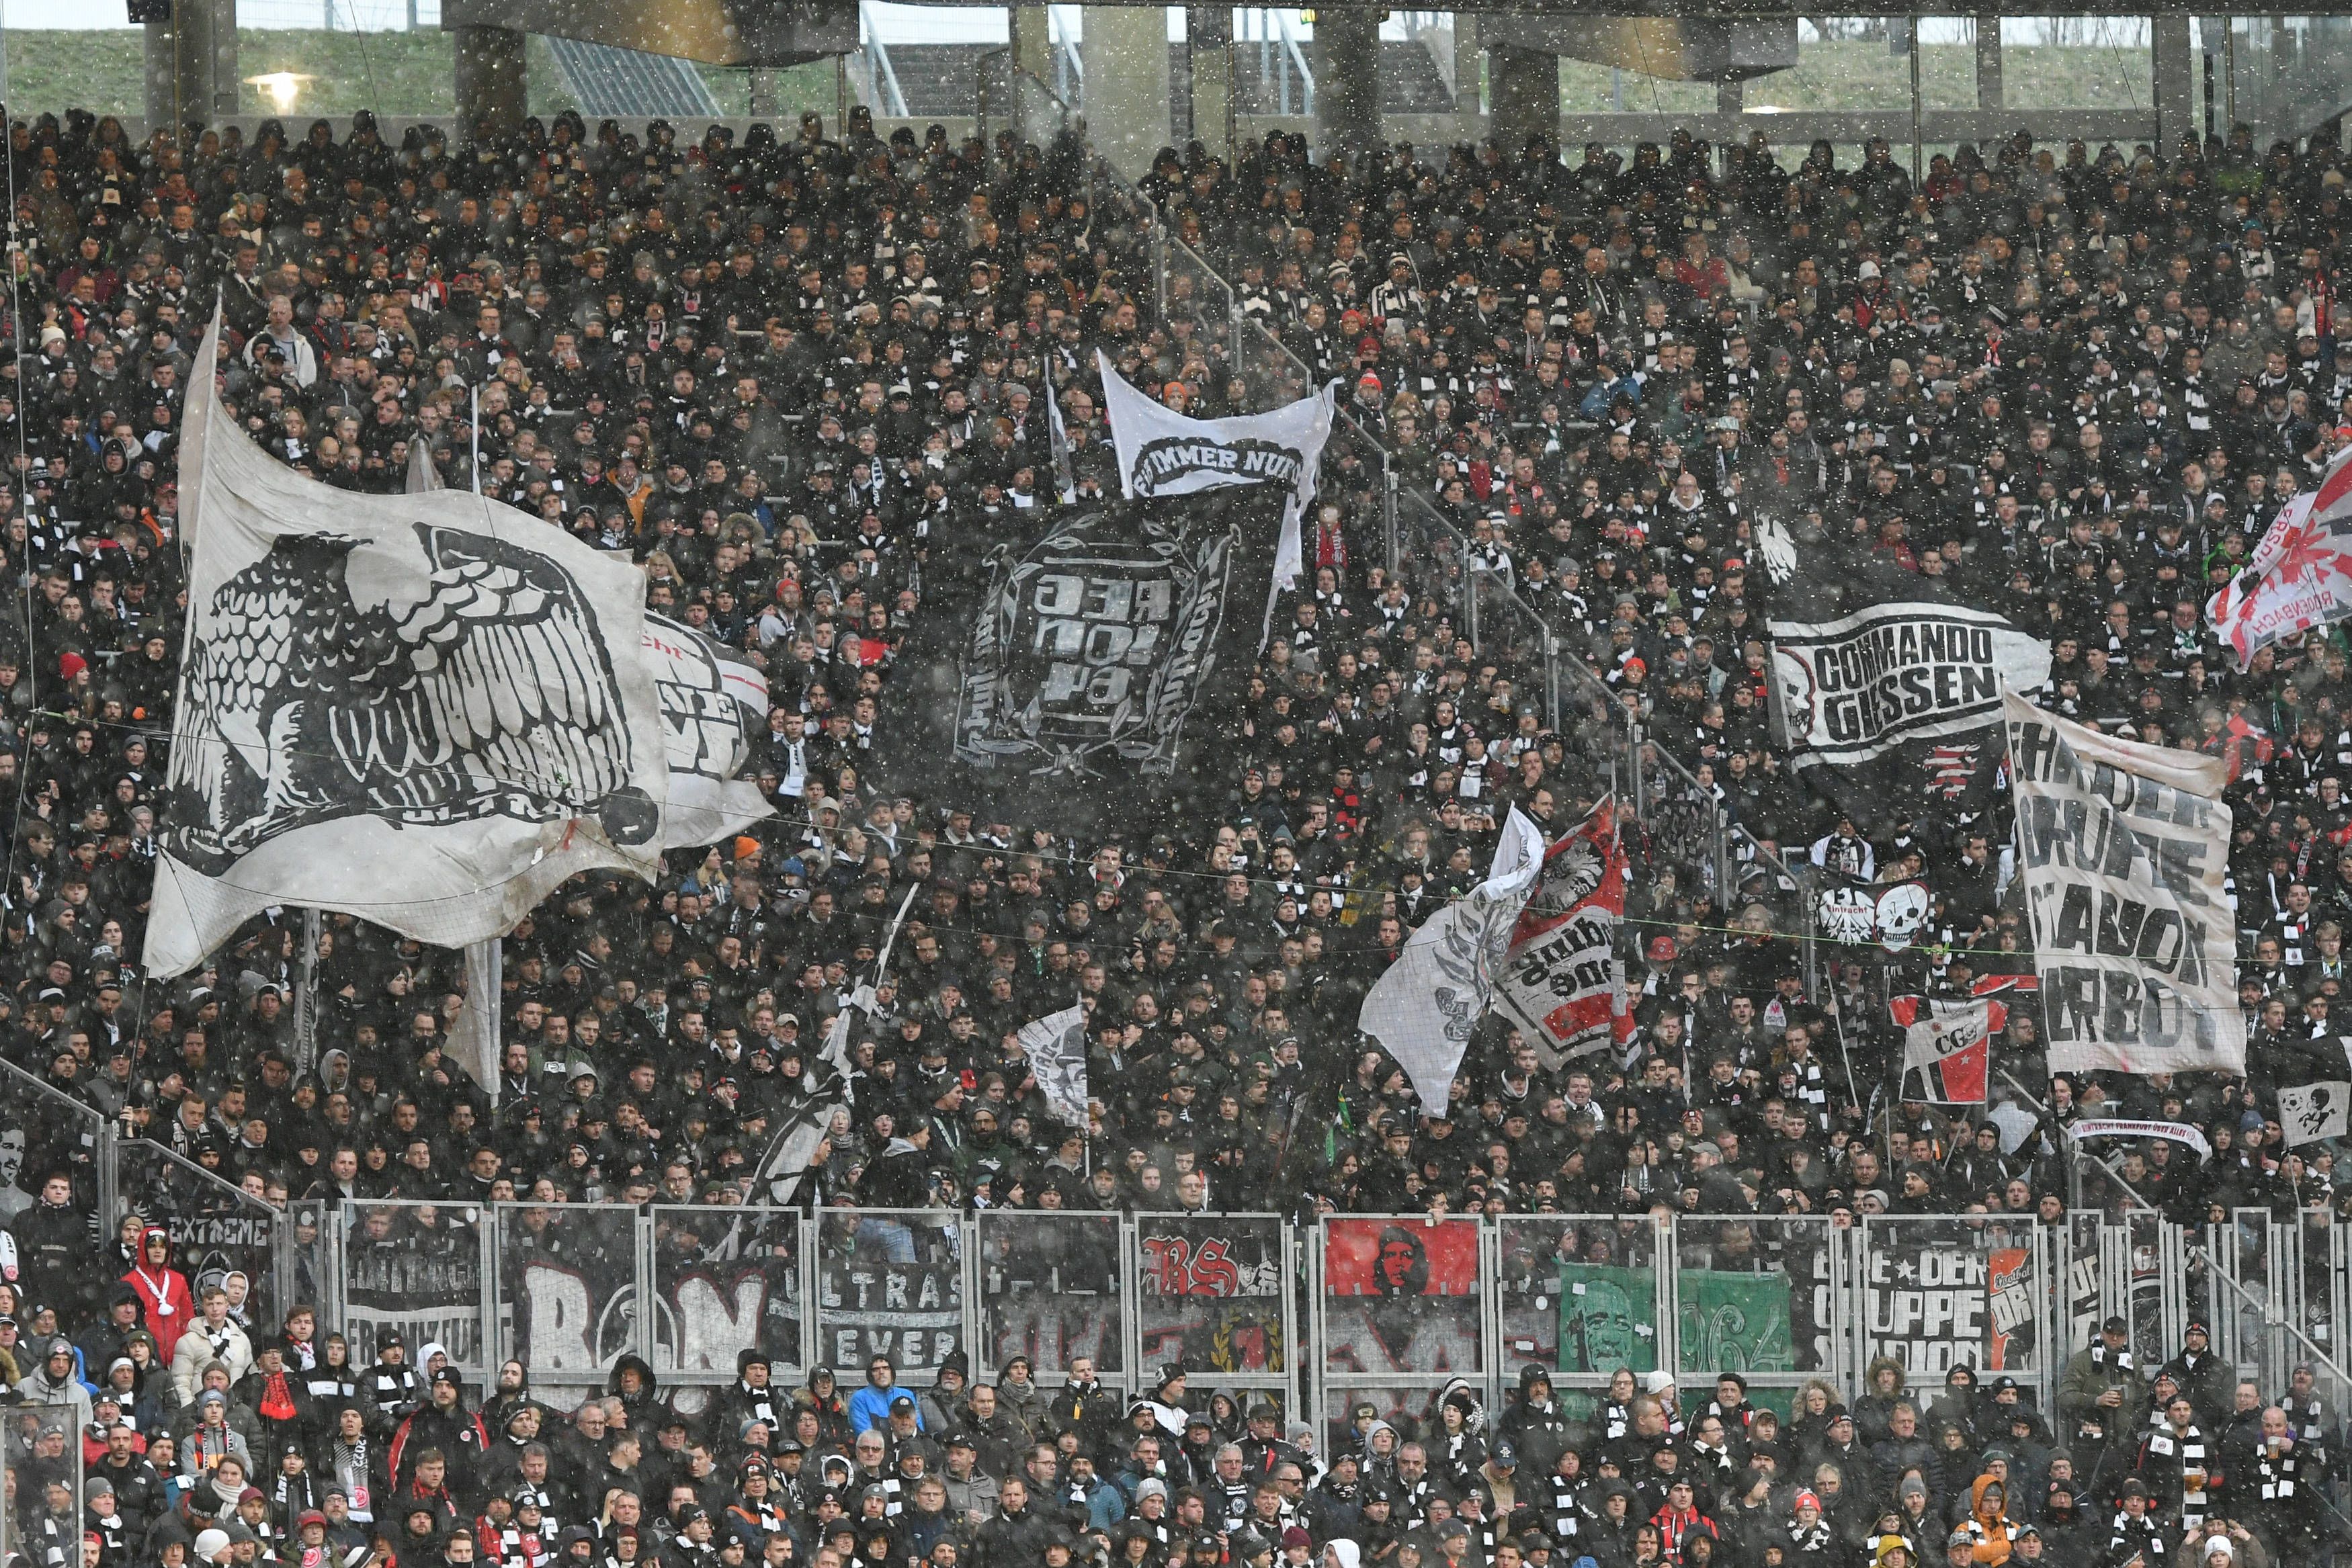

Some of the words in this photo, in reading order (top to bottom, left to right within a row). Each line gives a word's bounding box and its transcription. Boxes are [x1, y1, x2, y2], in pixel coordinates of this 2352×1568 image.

[1148, 444, 1238, 474] IMMER
[1814, 623, 1993, 692] COMMANDO
[1824, 665, 1997, 742] GIESSEN
[2116, 1123, 2151, 1131] FRANKFURT
[169, 1215, 269, 1247] EXTREME
[1919, 1250, 1986, 1287] DER
[1814, 1284, 1985, 1338] GUPPE
[347, 1317, 513, 1368] FRNKFUT
[1814, 1335, 1982, 1372] SADION
